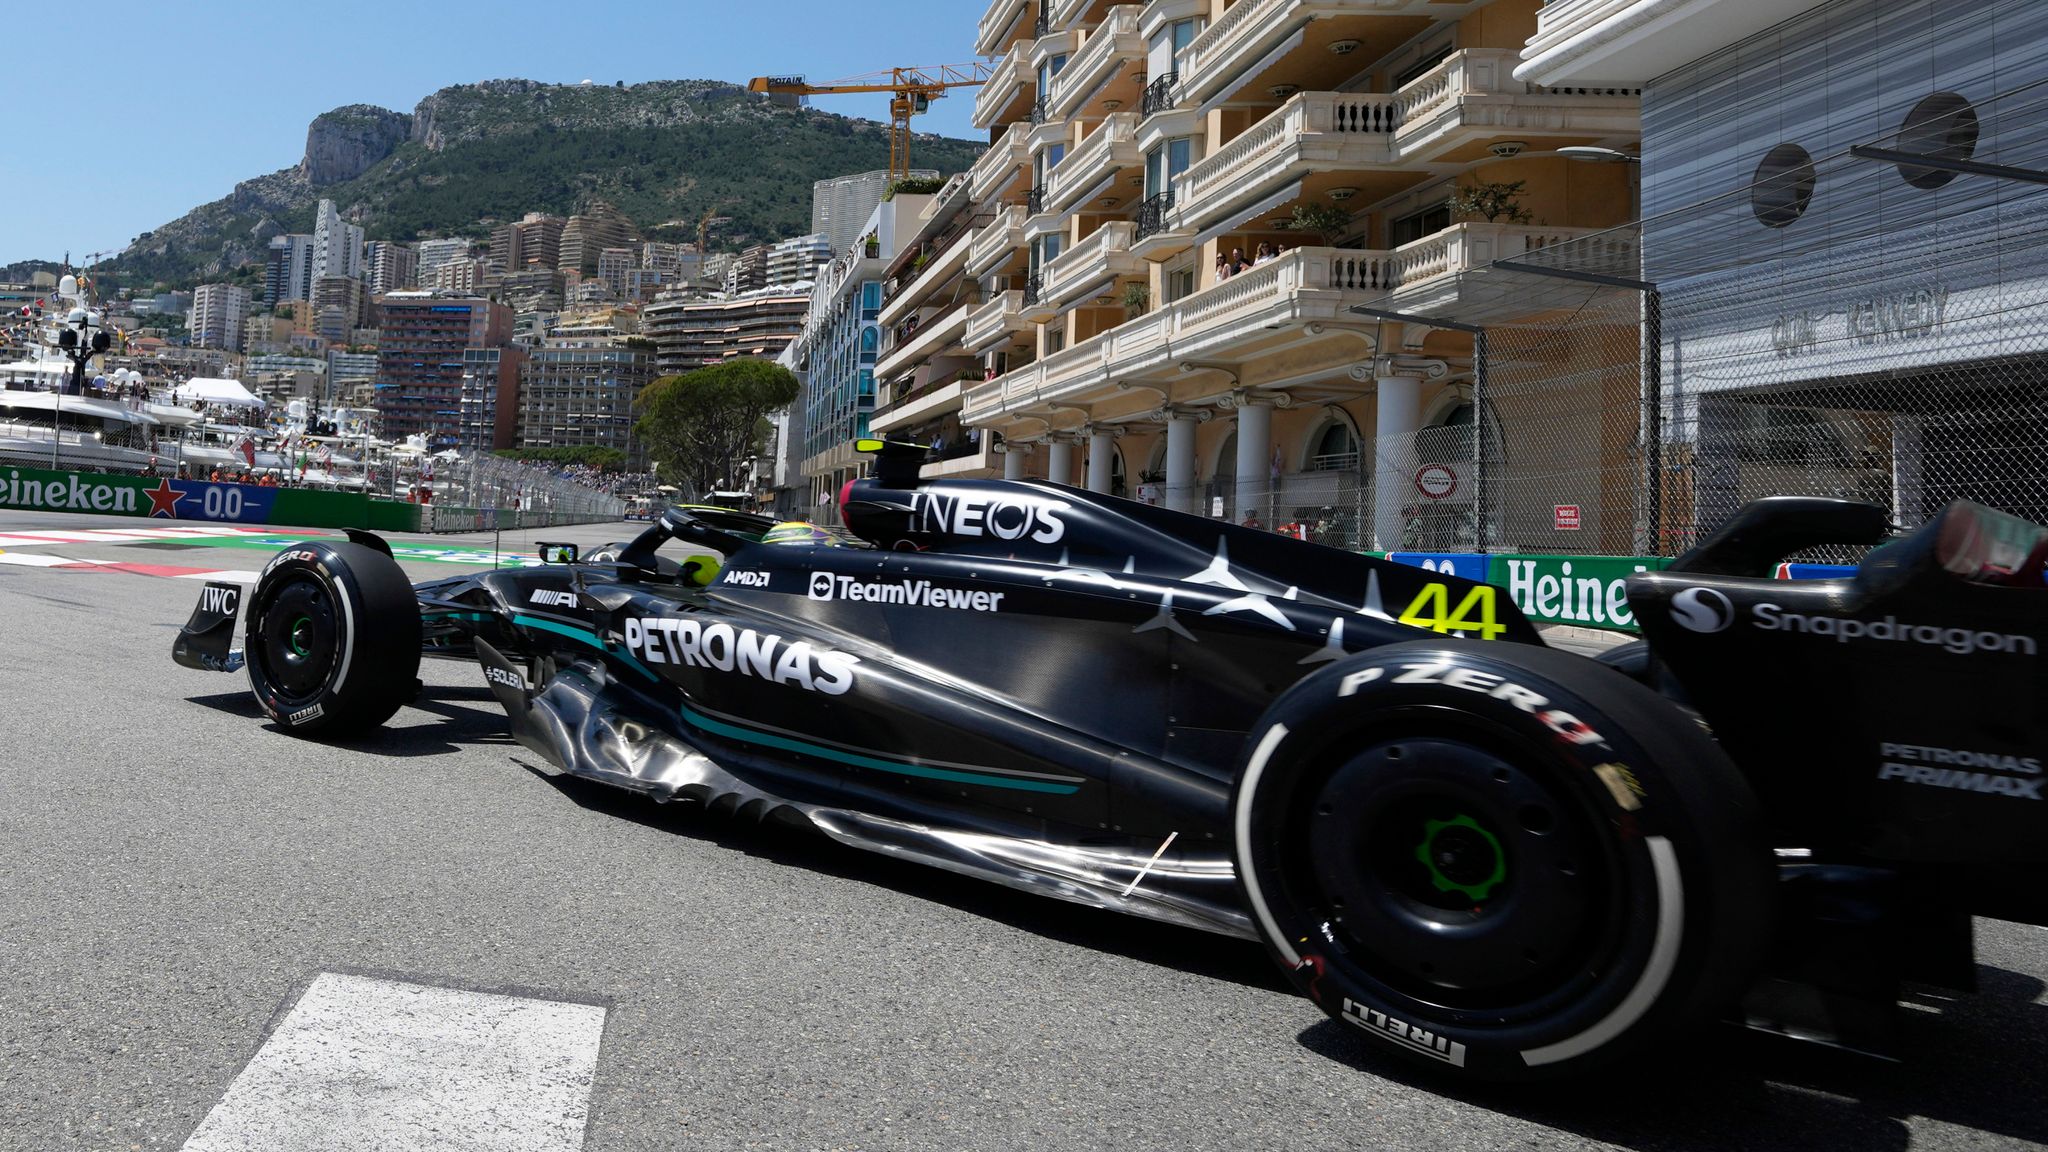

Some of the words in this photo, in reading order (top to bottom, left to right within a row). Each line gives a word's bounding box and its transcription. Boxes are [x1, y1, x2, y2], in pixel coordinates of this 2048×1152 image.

[768, 76, 802, 86] POTAIN
[435, 509, 475, 530] Heineken
[907, 493, 1072, 544] INEOS
[264, 550, 313, 577] ZERO
[723, 570, 758, 586] AMD
[202, 586, 237, 615] IWC
[836, 575, 1004, 612] TeamViewer
[1398, 582, 1507, 640] 44
[1508, 559, 1647, 628] Heine
[1752, 603, 2037, 654] Snapdragon
[625, 617, 863, 696] PETRONAS
[493, 668, 525, 691] SOLERA
[289, 703, 325, 726] PIRELLI
[1338, 667, 1384, 698] P
[1391, 660, 1605, 746] ZERO
[1880, 742, 2043, 774] PETRONAS
[1877, 762, 2047, 800] PRIMAX
[1341, 997, 1466, 1068] PIRELLI
